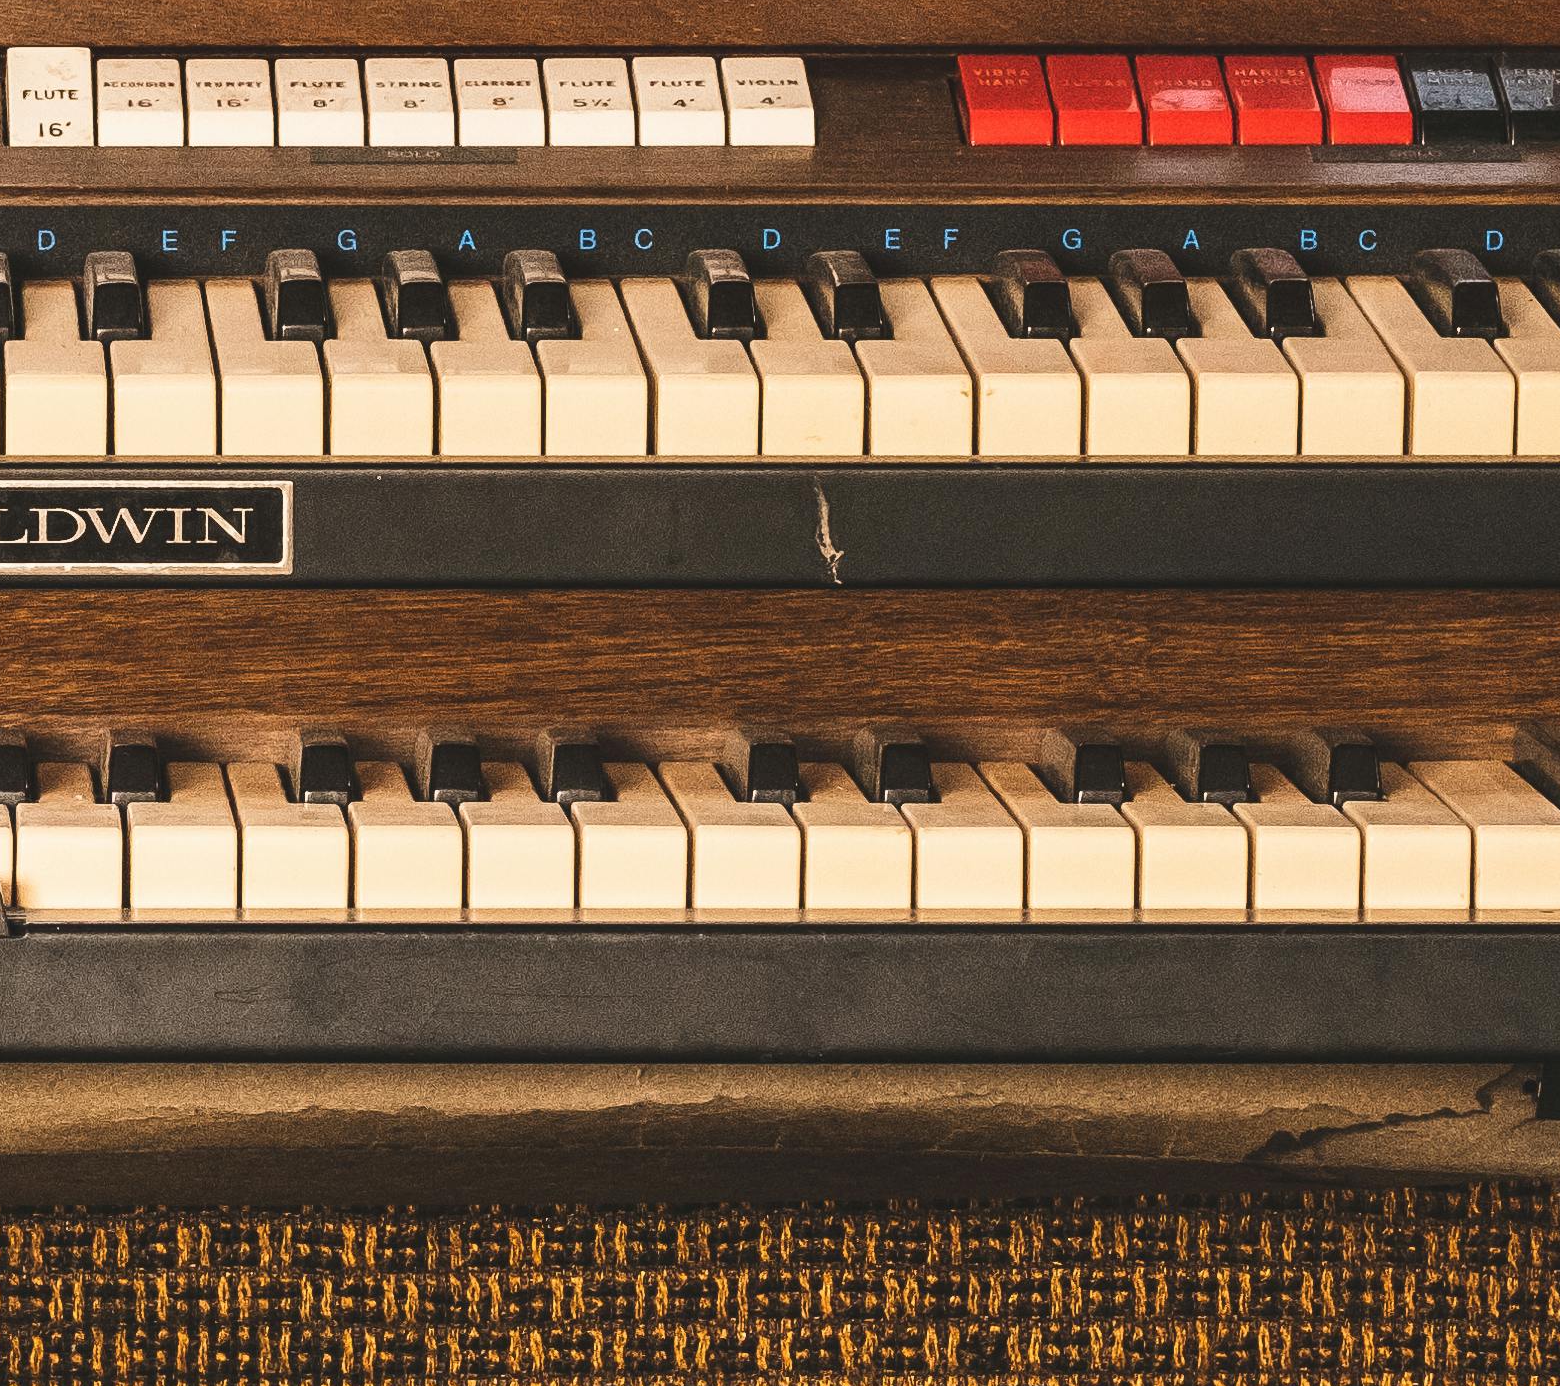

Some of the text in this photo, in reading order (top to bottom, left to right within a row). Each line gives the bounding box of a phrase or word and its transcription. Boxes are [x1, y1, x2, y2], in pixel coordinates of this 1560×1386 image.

[558, 80, 617, 88] FLUTE
[649, 79, 706, 88] FLUTE
[22, 89, 79, 101] FLUTE
[38, 121, 72, 138] 16'
[37, 229, 57, 252] D
[161, 229, 178, 252] E
[221, 229, 237, 252] F
[337, 229, 357, 252] G
[458, 229, 476, 252] A
[580, 229, 597, 252] B
[634, 229, 653, 252] C
[763, 229, 781, 252] D
[885, 229, 901, 252] E
[944, 229, 959, 252] F
[1062, 229, 1082, 252] G
[1183, 229, 1200, 252] A
[1300, 229, 1318, 252] B
[1358, 229, 1377, 252] C
[1486, 229, 1504, 252] D
